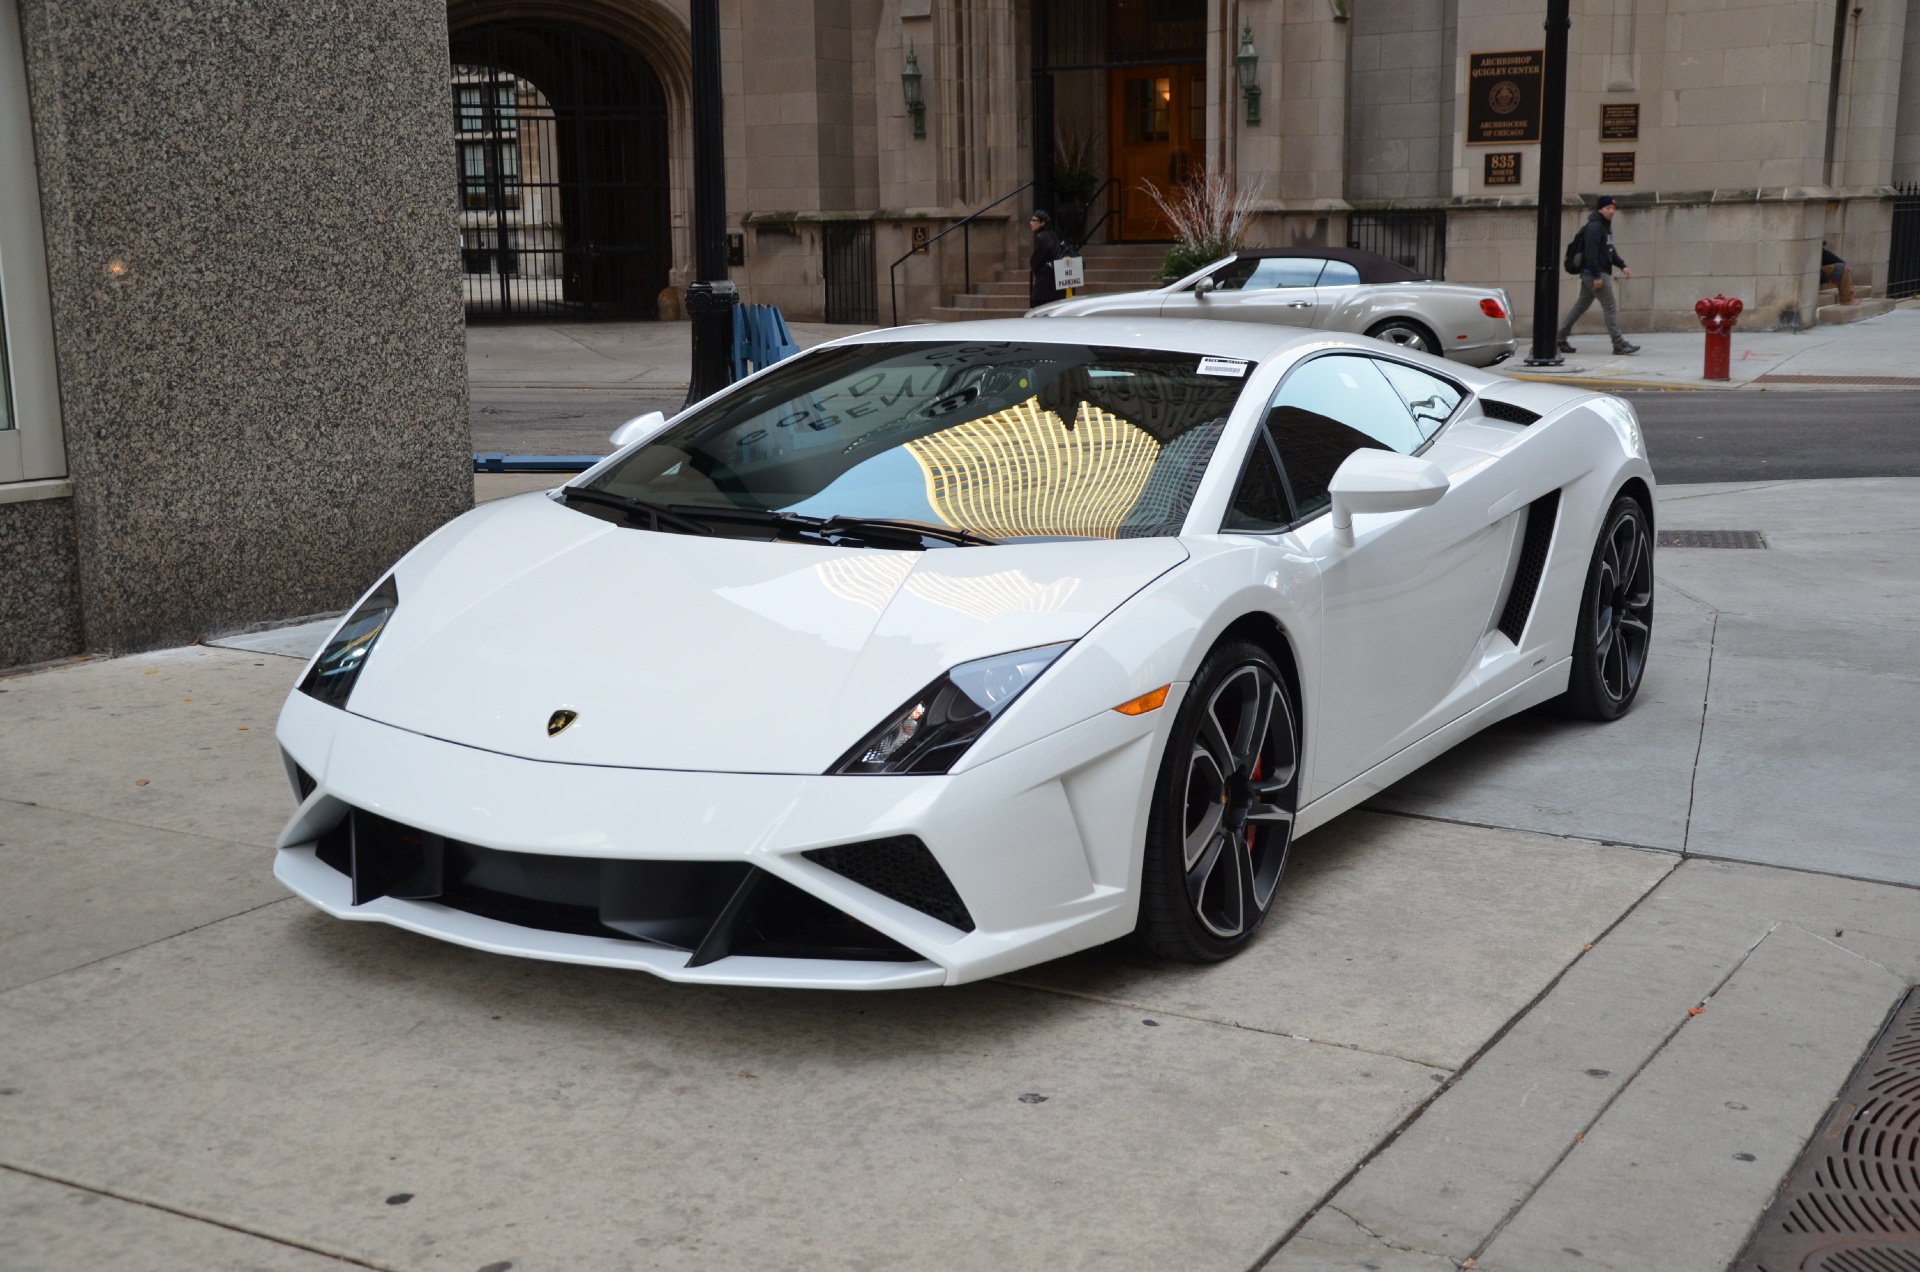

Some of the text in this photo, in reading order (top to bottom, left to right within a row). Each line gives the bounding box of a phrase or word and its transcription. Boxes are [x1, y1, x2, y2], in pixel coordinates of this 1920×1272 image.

[1480, 56, 1532, 66] ARCHBISHOP
[1472, 65, 1540, 77] QUIGLEY CENTER
[1480, 120, 1528, 129] ARCHDIOCESE
[1483, 128, 1524, 137] OF CHICAGO
[1491, 155, 1515, 168] 835
[1065, 269, 1073, 277] NO
[1058, 277, 1081, 287] PARKING
